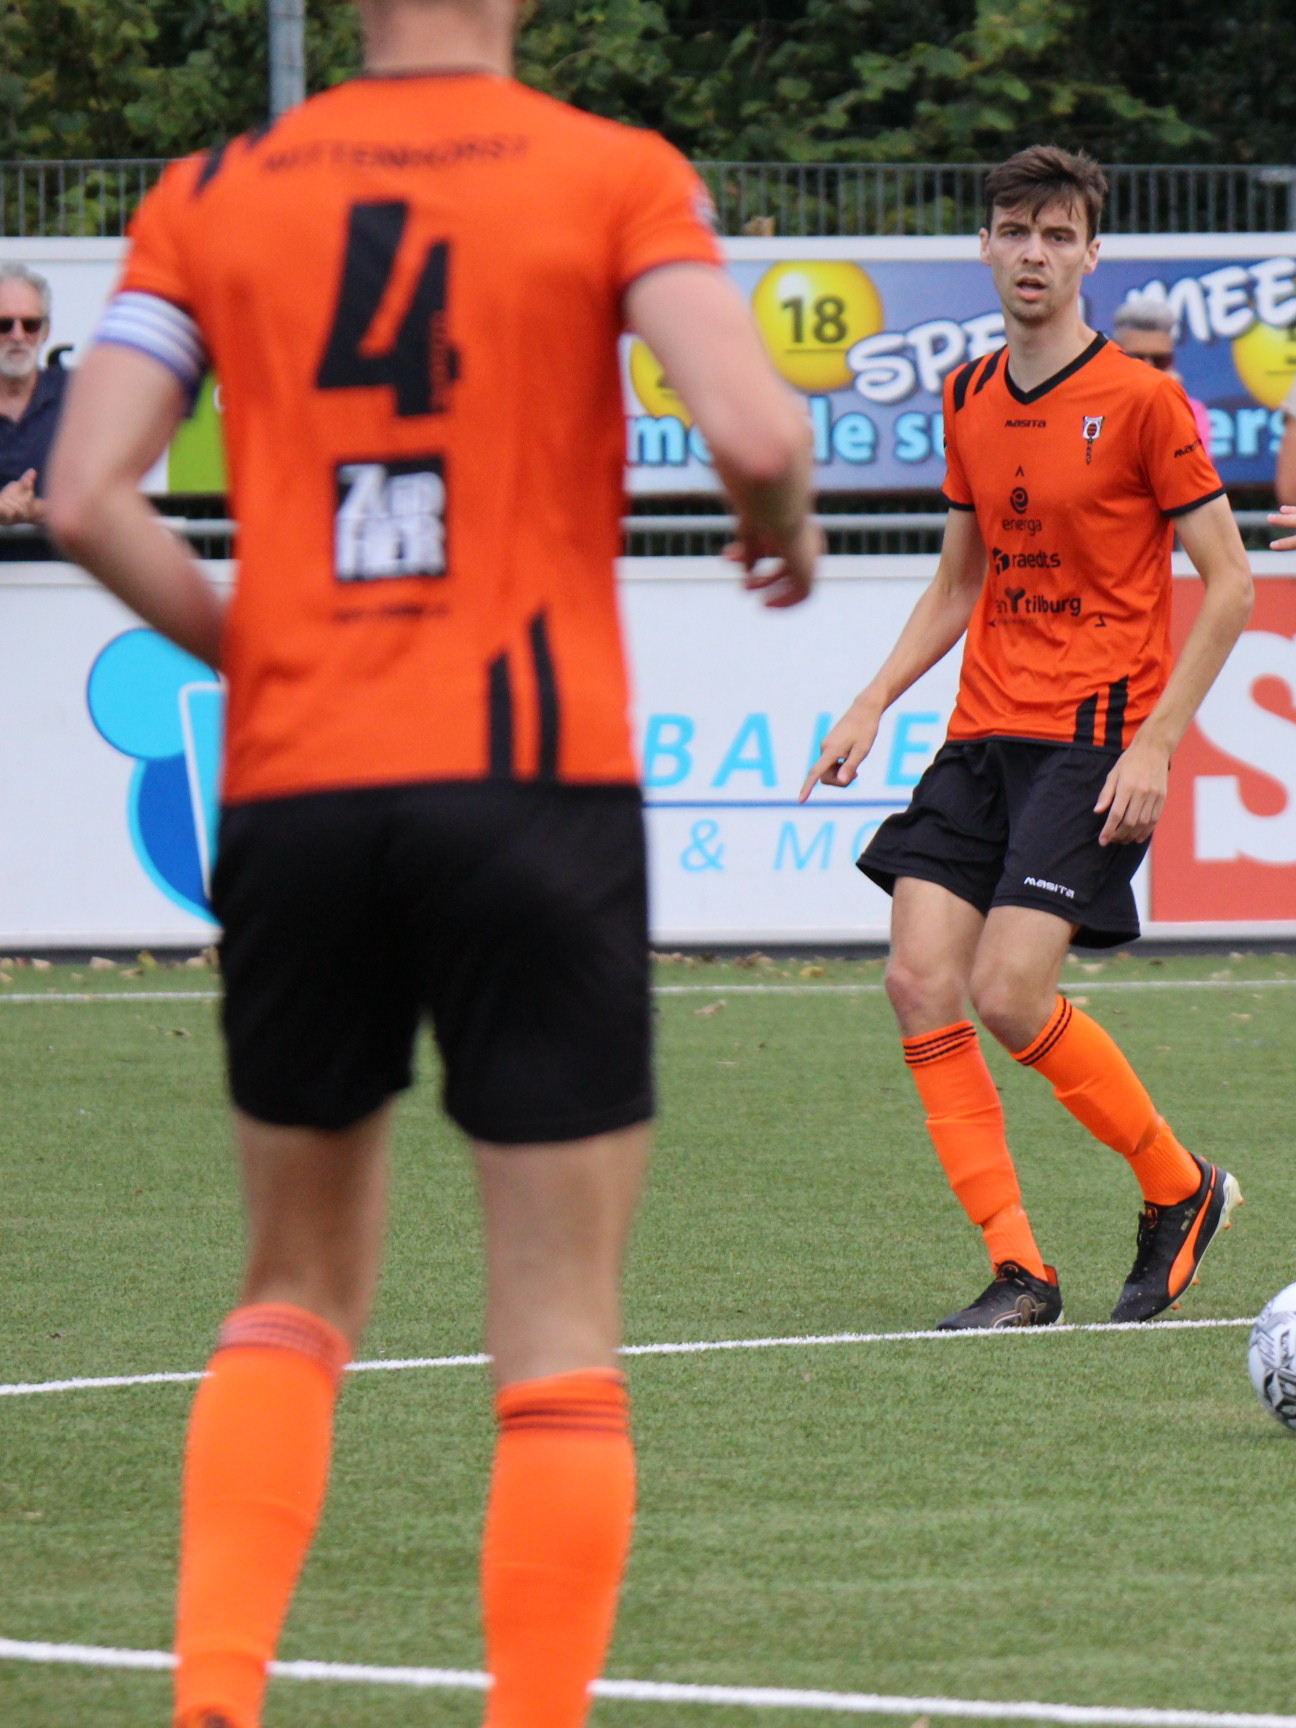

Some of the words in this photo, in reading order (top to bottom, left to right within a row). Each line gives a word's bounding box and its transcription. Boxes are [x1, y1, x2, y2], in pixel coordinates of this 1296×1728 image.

[314, 197, 460, 418] 4
[781, 296, 849, 345] 18
[1002, 518, 1043, 536] energa
[1012, 549, 1061, 569] raedts
[1025, 595, 1082, 617] tilburg
[679, 818, 726, 873] &
